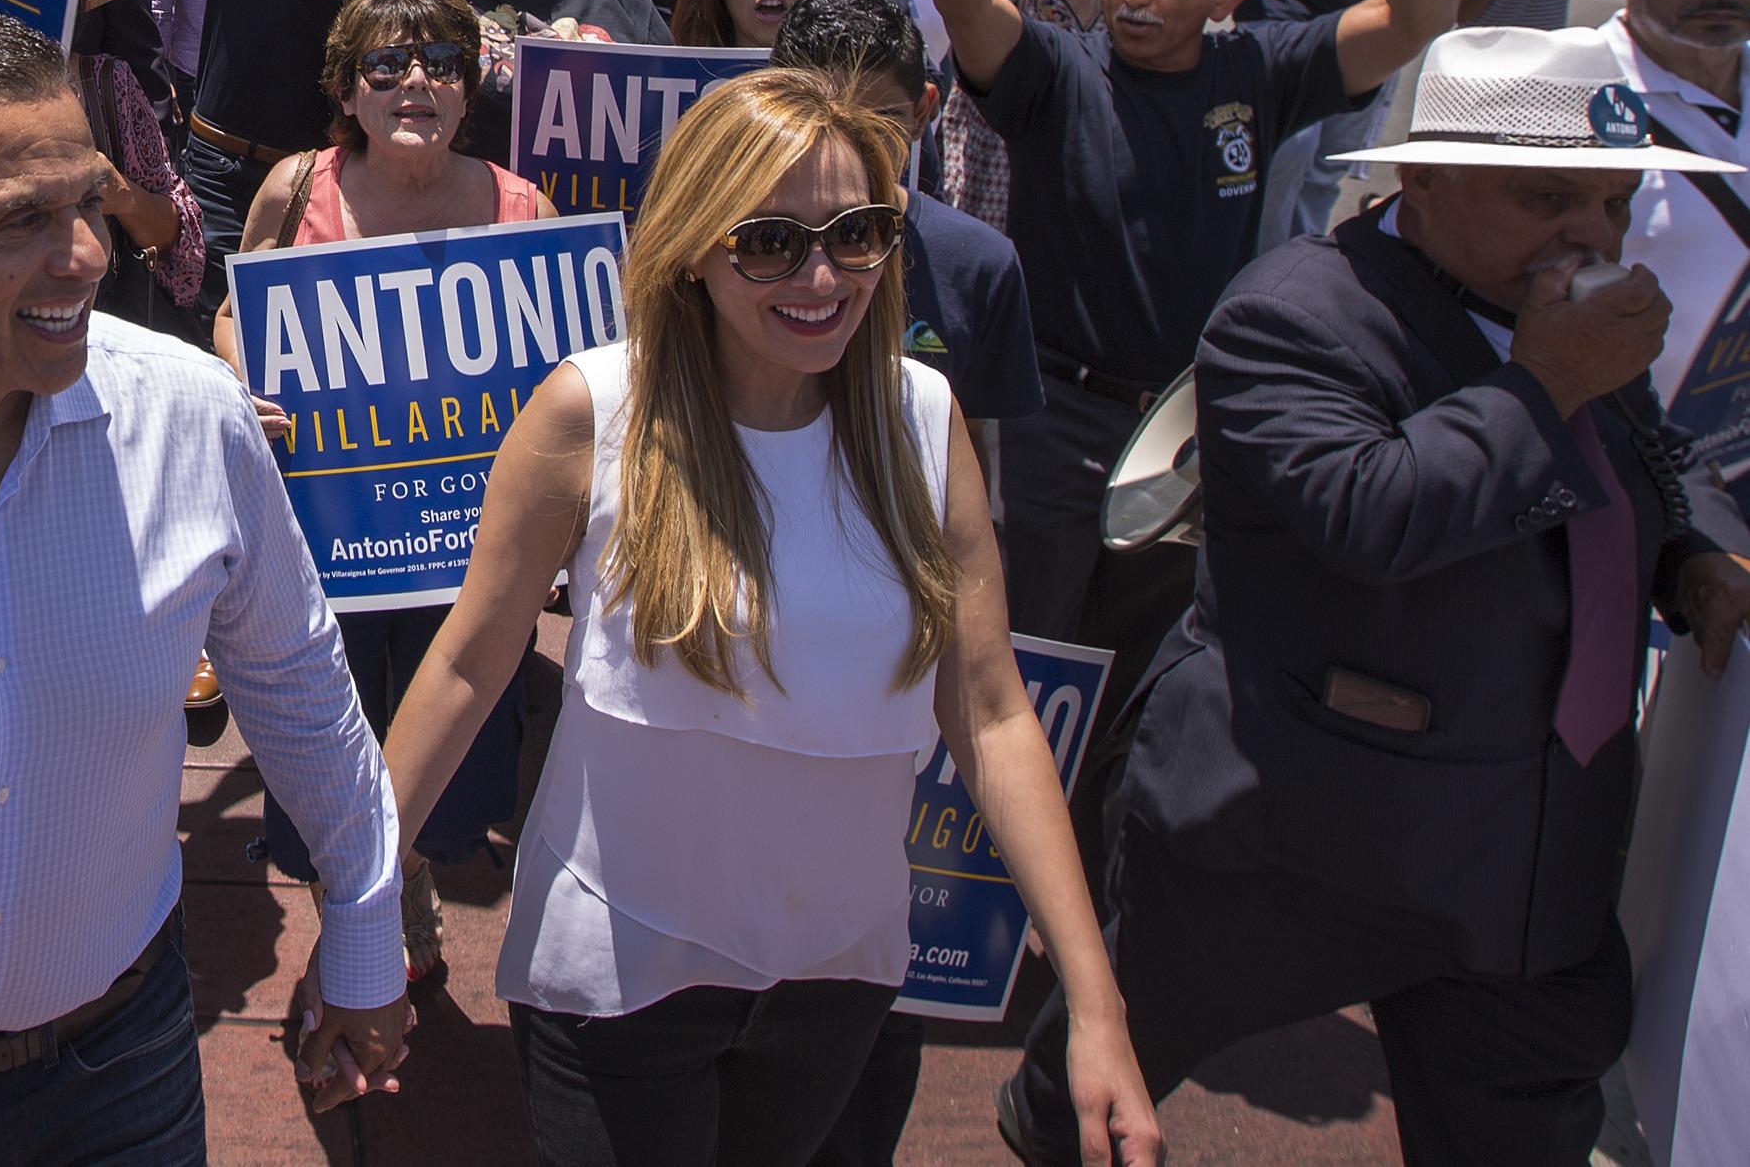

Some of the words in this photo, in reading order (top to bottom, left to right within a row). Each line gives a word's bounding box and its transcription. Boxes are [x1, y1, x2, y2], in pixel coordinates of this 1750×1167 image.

[1606, 121, 1638, 135] ANTONIO
[541, 170, 635, 211] VILL
[264, 246, 627, 396] ANTONIO
[374, 478, 429, 502] FOR
[420, 507, 461, 523] Share
[331, 567, 366, 579] Villaraigosa
[378, 564, 406, 575] Governor
[407, 562, 427, 572] 2018.
[428, 560, 447, 570] FPPC
